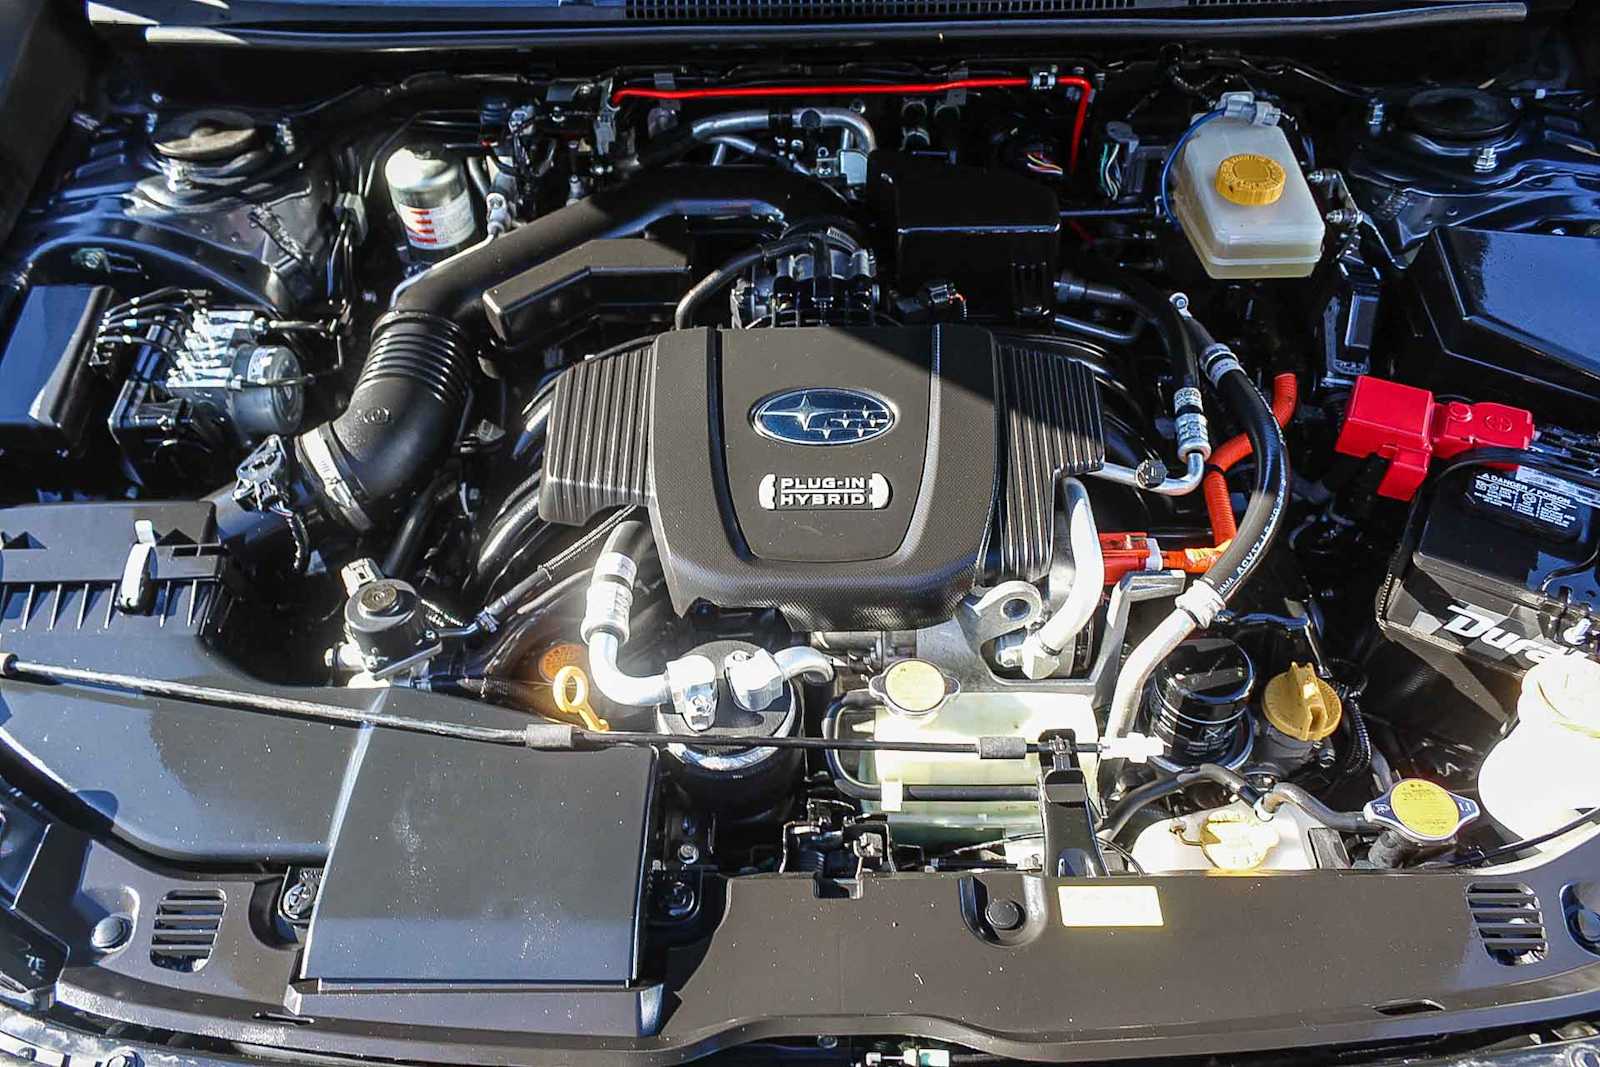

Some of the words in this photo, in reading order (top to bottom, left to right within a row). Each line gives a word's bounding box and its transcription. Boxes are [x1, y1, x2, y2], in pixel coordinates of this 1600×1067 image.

[780, 477, 865, 489] PLUG-IN
[1491, 475, 1528, 491] DANGER
[1536, 489, 1571, 504] POISON
[780, 492, 866, 505] HYBRID
